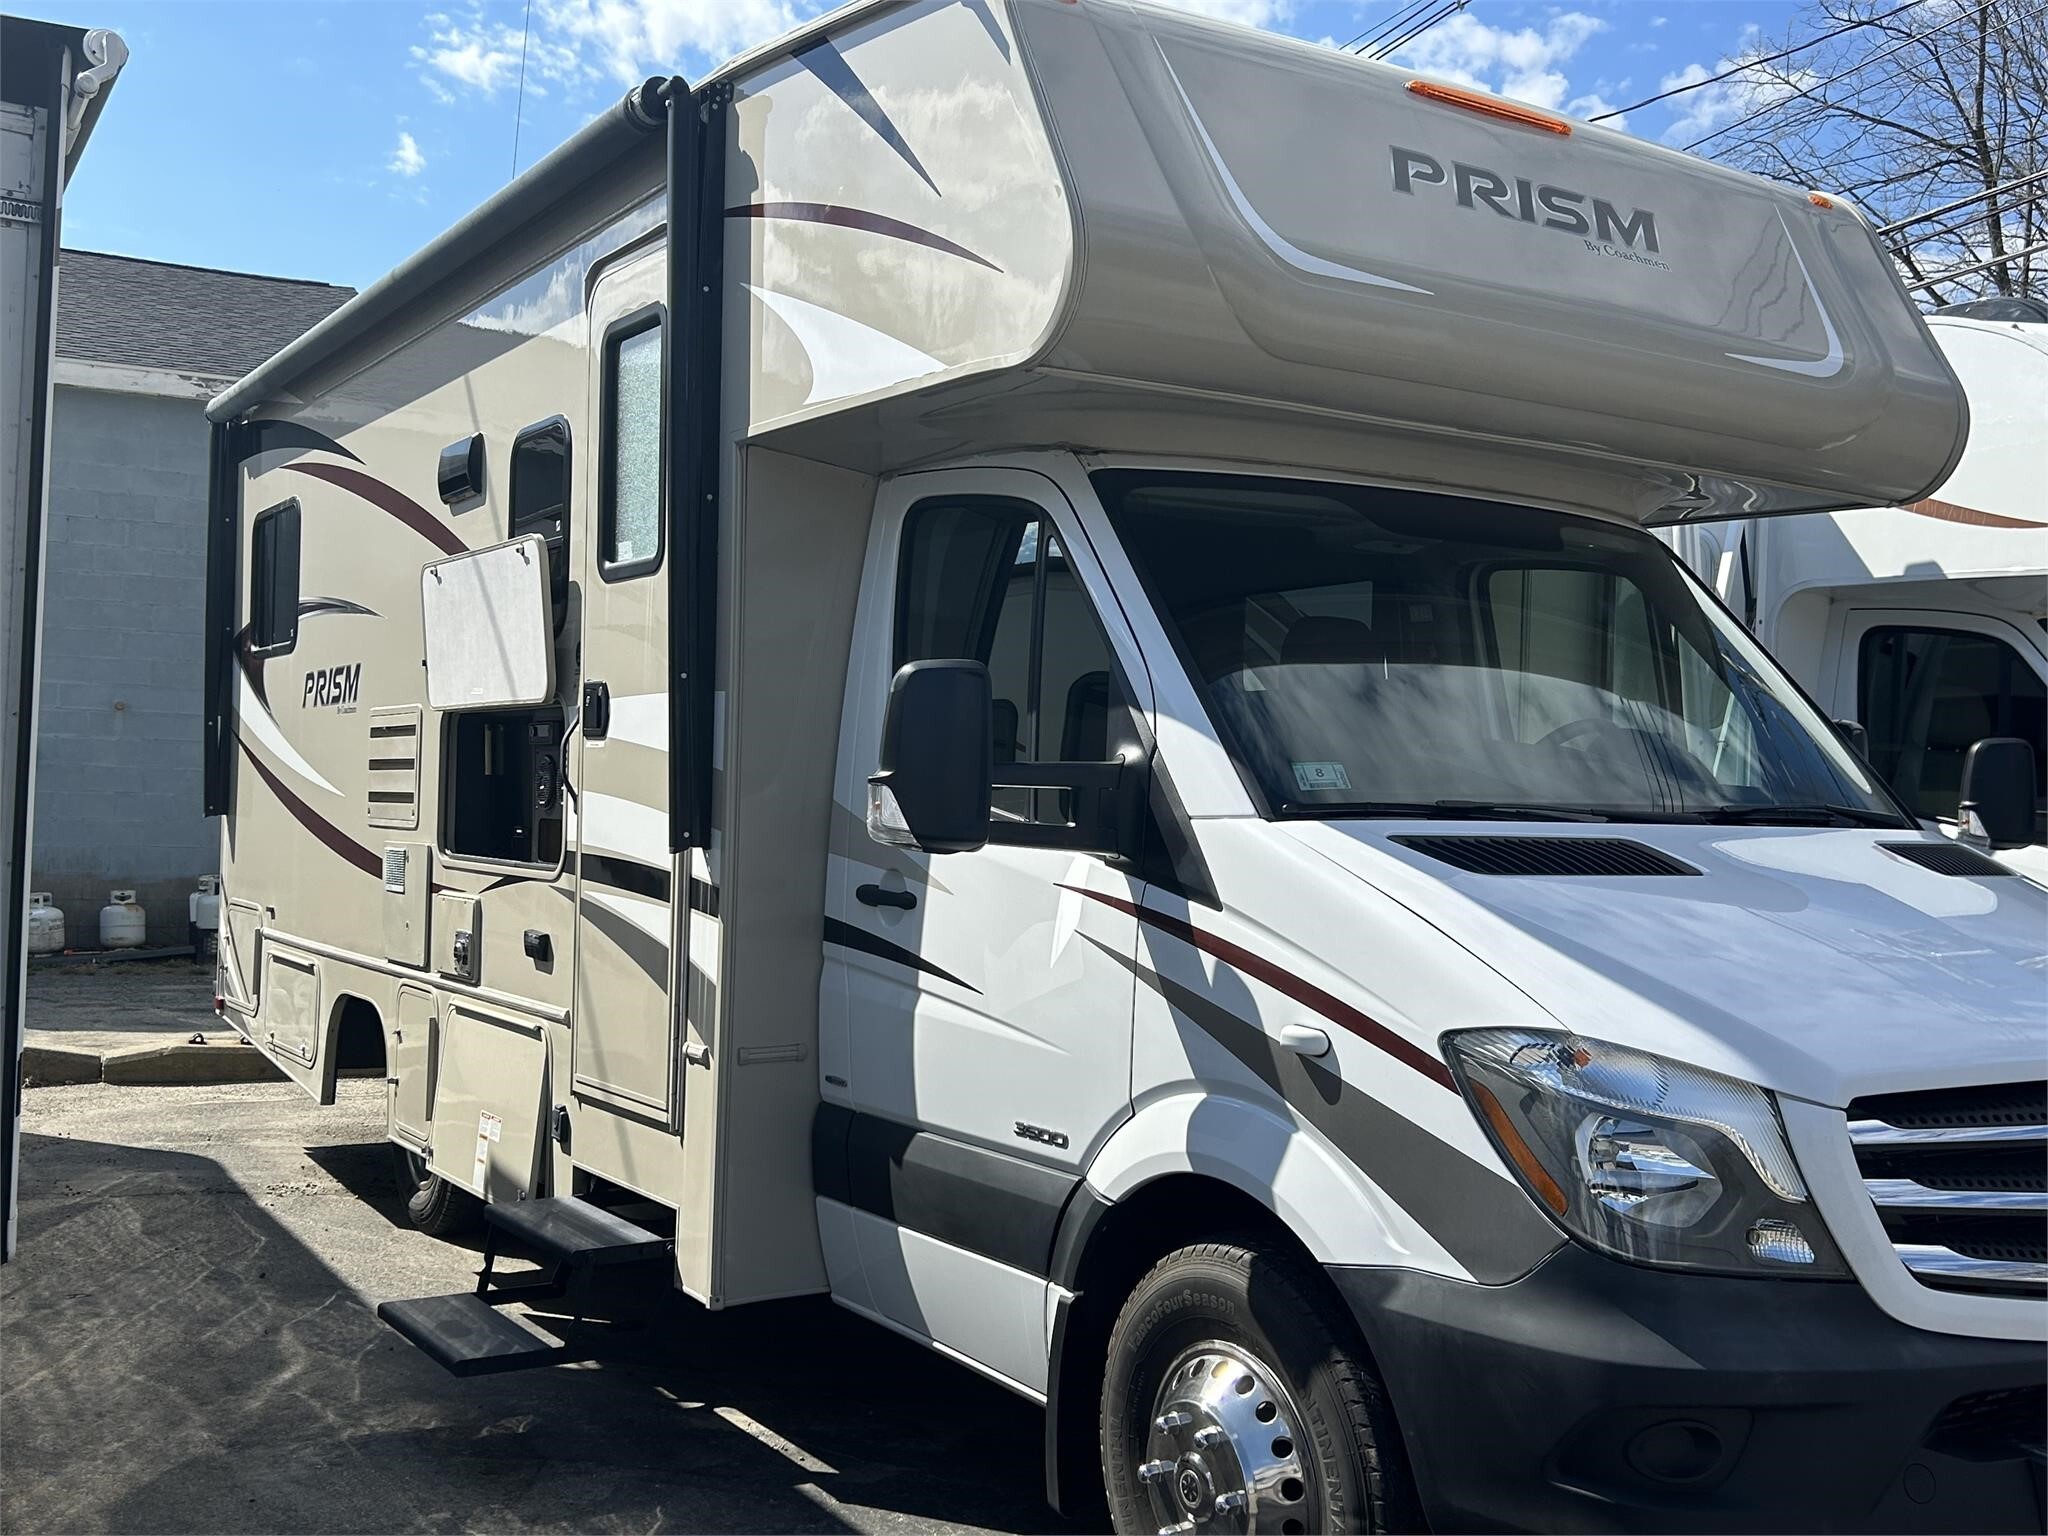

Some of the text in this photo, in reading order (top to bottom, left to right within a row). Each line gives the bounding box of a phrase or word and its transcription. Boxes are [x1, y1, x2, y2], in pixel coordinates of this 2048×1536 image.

[1389, 145, 1661, 254] PRISM
[1583, 239, 1671, 271] By Coachmen
[302, 662, 362, 709] PRISM
[1315, 768, 1325, 778] 8
[1013, 1121, 1070, 1150] 3500
